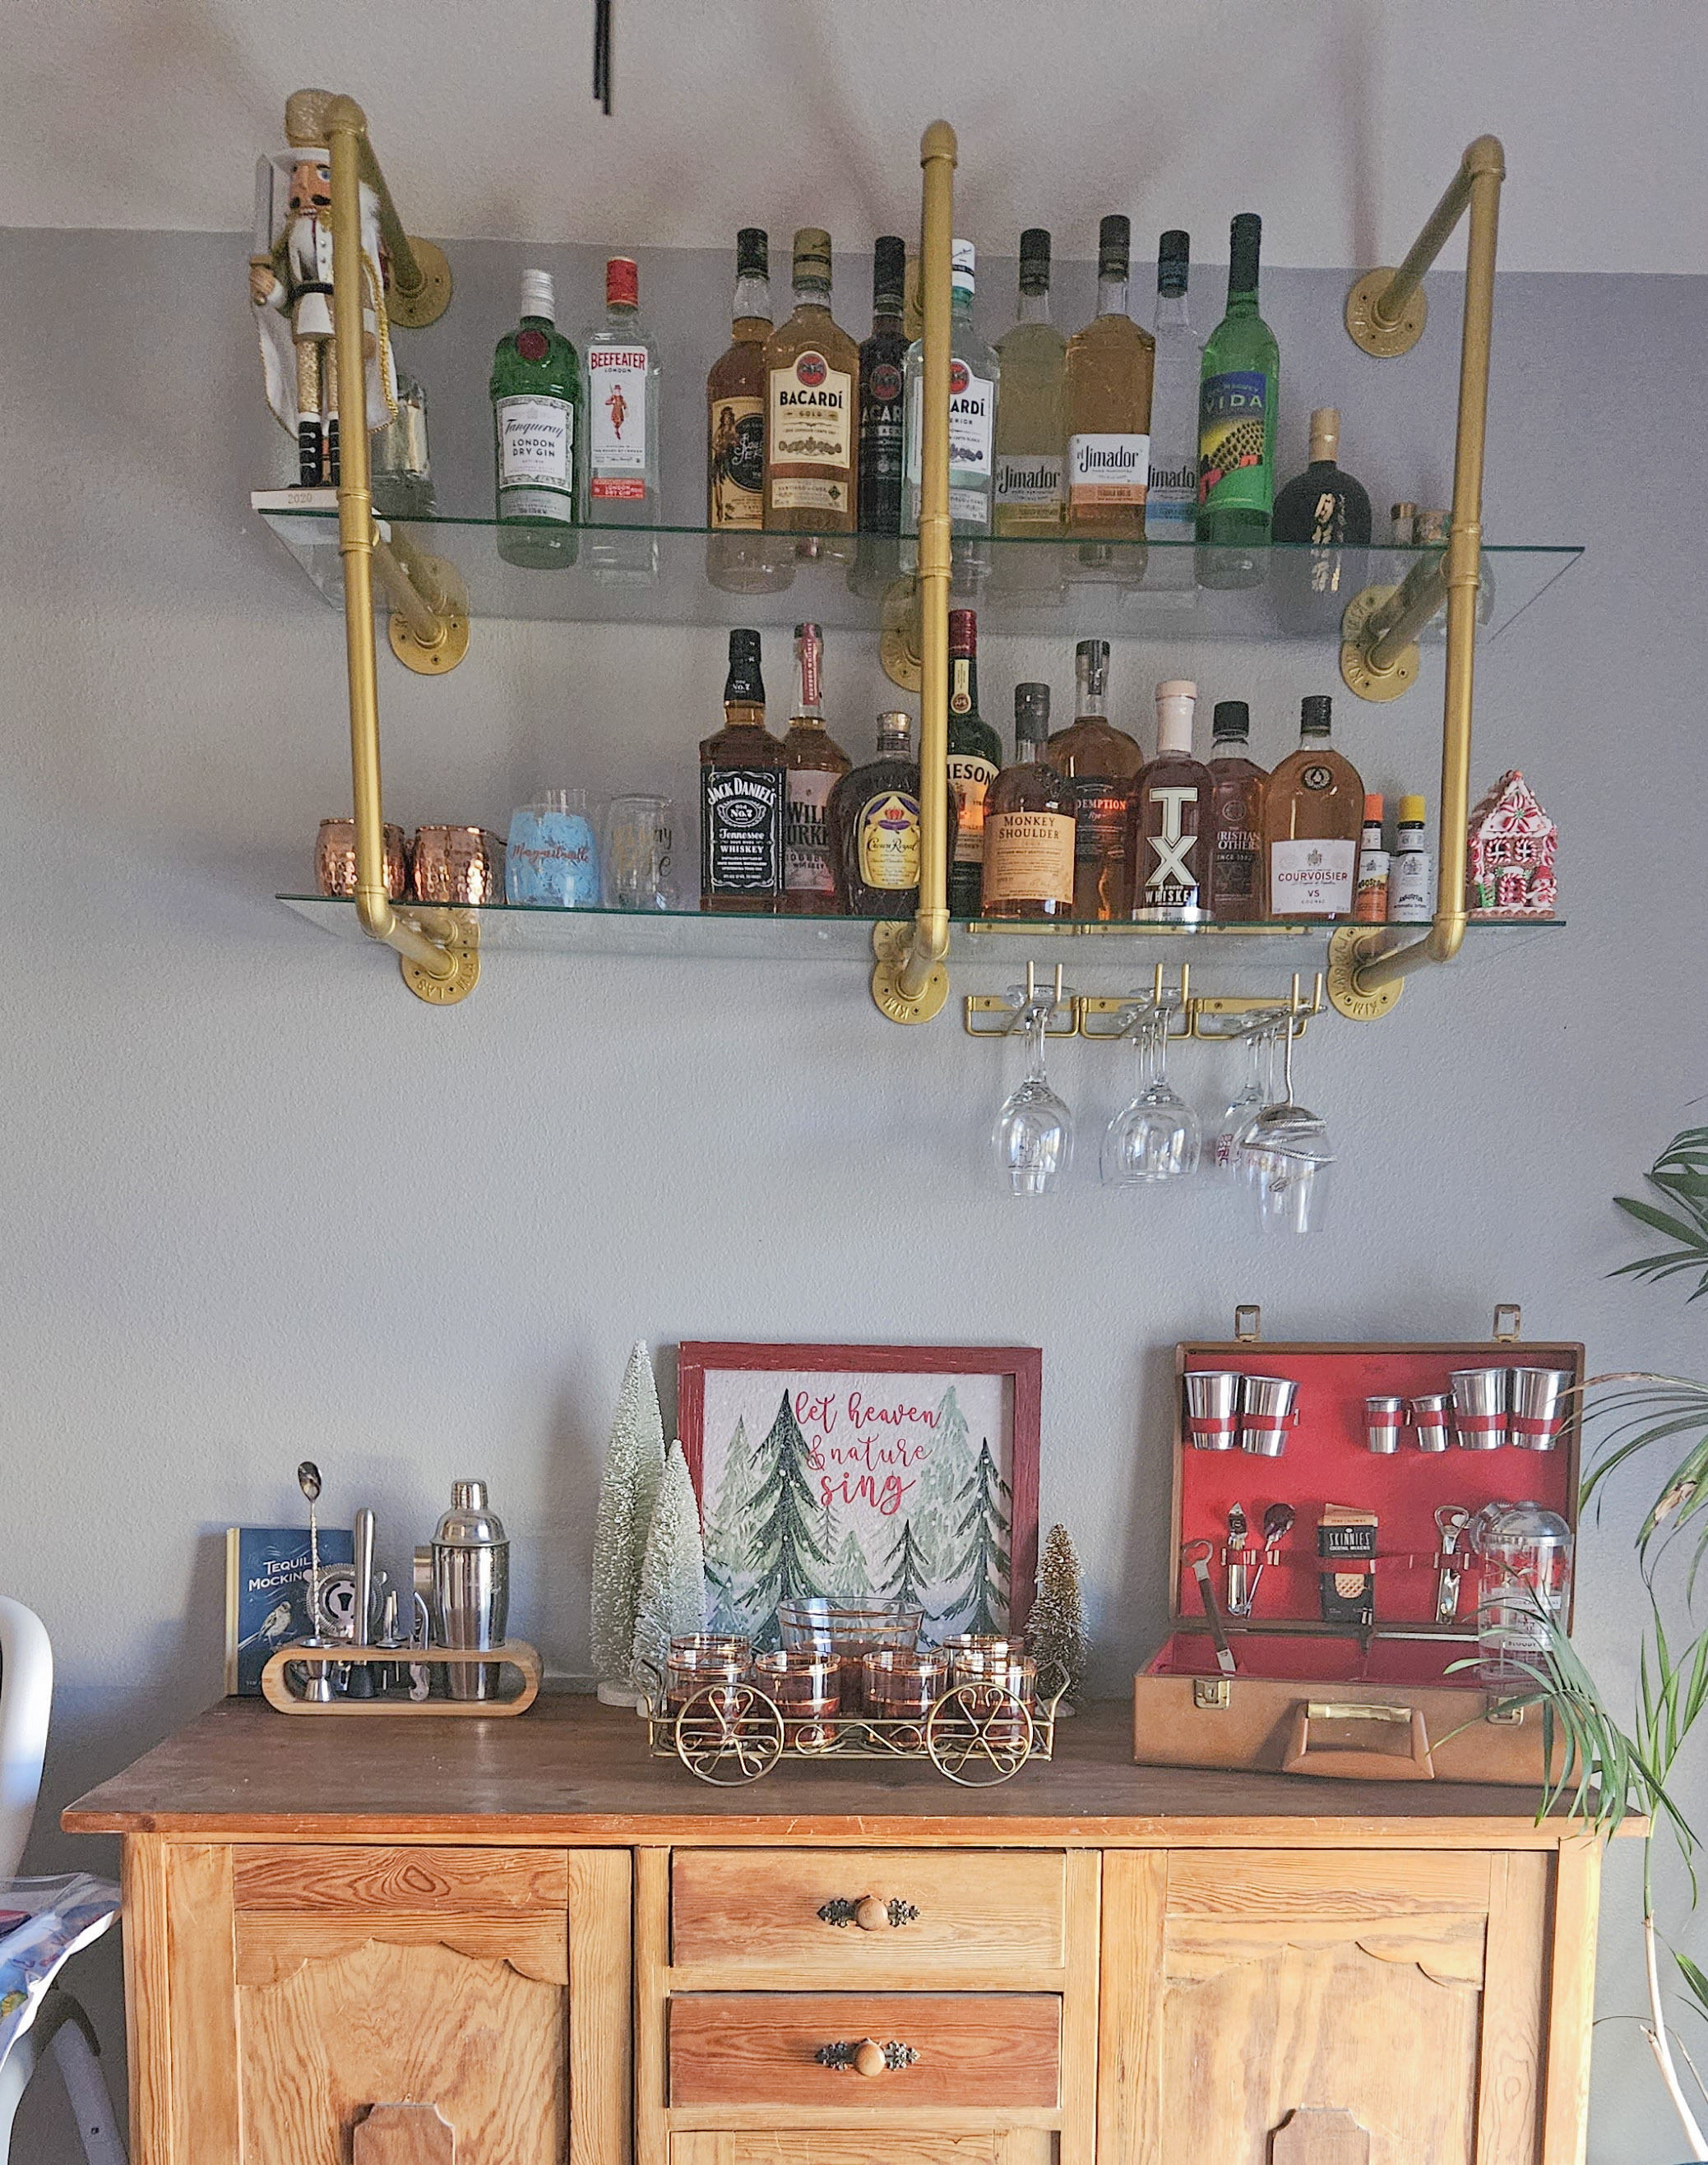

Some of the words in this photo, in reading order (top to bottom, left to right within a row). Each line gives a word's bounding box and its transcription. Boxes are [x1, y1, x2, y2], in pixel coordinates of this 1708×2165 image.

[591, 353, 646, 370] BEEFEATER
[780, 391, 843, 409] BACARDÍ
[951, 398, 985, 416] ARDÍ
[505, 419, 564, 437] Tanqueray
[513, 439, 555, 448] LONDON
[513, 448, 532, 456] DRY
[536, 449, 555, 457] GIN
[1080, 445, 1139, 473] Jimador
[999, 465, 1061, 493] Jimador
[1146, 465, 1195, 493] Jimado
[288, 493, 312, 504] 2020
[947, 763, 993, 789] ESON
[707, 782, 734, 804] JACK
[1077, 798, 1127, 810] DEMPTION
[1004, 816, 1056, 826] MONKEY
[720, 828, 765, 840] Tennessee
[999, 828, 1059, 839] SHOULDER
[1218, 831, 1261, 840] RISTIAN
[720, 845, 764, 854] WHISKEY
[1218, 840, 1261, 850] OTHERS
[1278, 872, 1348, 881] COURVOISIER
[796, 1391, 837, 1434] let
[849, 1392, 942, 1429] heaven
[831, 1434, 933, 1471] nature
[821, 1472, 916, 1515] sing
[1329, 1532, 1371, 1546] SKINNIES
[248, 1571, 303, 1592] MOCKIN
